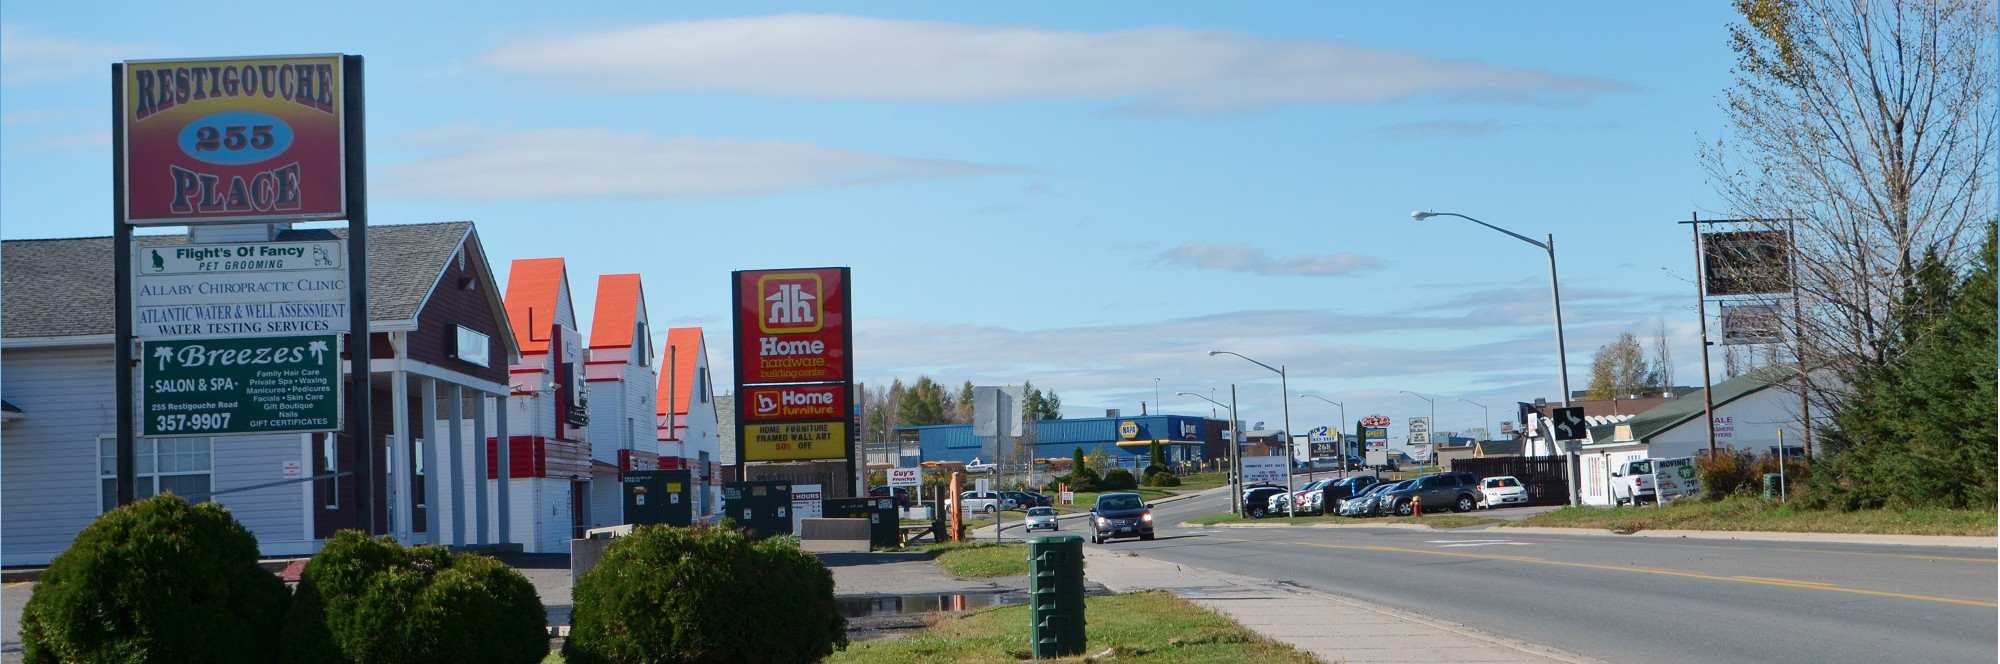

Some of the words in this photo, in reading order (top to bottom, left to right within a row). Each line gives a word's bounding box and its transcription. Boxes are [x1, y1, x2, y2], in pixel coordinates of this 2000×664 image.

[135, 63, 335, 123] RESTIGOUCHE
[195, 124, 274, 152] 255
[170, 161, 301, 214] PLACE
[176, 247, 232, 261] Flight's
[236, 246, 256, 257] Of
[259, 245, 305, 259] Fancy
[199, 261, 220, 271] PET
[224, 260, 284, 271] GROOMING
[140, 283, 195, 297] ALLABY
[198, 281, 294, 295] CHIROPRACTIC
[297, 279, 344, 292] CLINIC
[140, 307, 192, 324] ATLANTIC
[195, 305, 232, 321] WATER
[234, 305, 243, 319] &
[245, 304, 276, 319] WELL
[277, 303, 345, 319] ASSESSMENT
[158, 323, 201, 336] WATER
[207, 322, 262, 334] TESTING
[267, 320, 329, 333] SERVICES
[759, 337, 825, 356] Home
[177, 344, 304, 368] Breezes
[760, 356, 825, 368] hardware
[256, 370, 282, 379] Family
[283, 369, 300, 377] Hair
[760, 368, 798, 379] building
[797, 369, 825, 377] centre
[155, 378, 195, 393] SALON
[198, 378, 208, 392] &
[210, 377, 234, 391] SPA
[249, 378, 277, 386] Private
[277, 377, 293, 387] Spa
[299, 377, 327, 386] Waxing
[246, 386, 286, 394] Manicures
[292, 385, 331, 393] Pedicures
[253, 394, 281, 403] Facials
[286, 393, 304, 401] Skin
[304, 393, 324, 401] Care
[782, 390, 834, 405] Home
[151, 403, 167, 411] 255
[167, 402, 216, 411] Restigouche
[218, 401, 238, 409] Road
[263, 402, 278, 410] Gift
[279, 402, 314, 411] Boutique
[782, 405, 834, 416] furniture
[278, 410, 298, 418] Nails
[156, 413, 231, 432] 357-9907
[249, 419, 269, 428] GIFT
[270, 418, 328, 427] CERTIFICATES
[759, 426, 781, 434] HOME
[785, 424, 828, 433] FURNITURE
[1122, 425, 1136, 434] NAPA
[756, 434, 788, 443] FRAMED
[791, 433, 813, 441] WALL
[815, 432, 832, 441] ART
[798, 442, 812, 450] OFF
[1317, 443, 1331, 451] 268
[1660, 458, 1691, 468] MOVING?
[894, 469, 914, 477] Guy's
